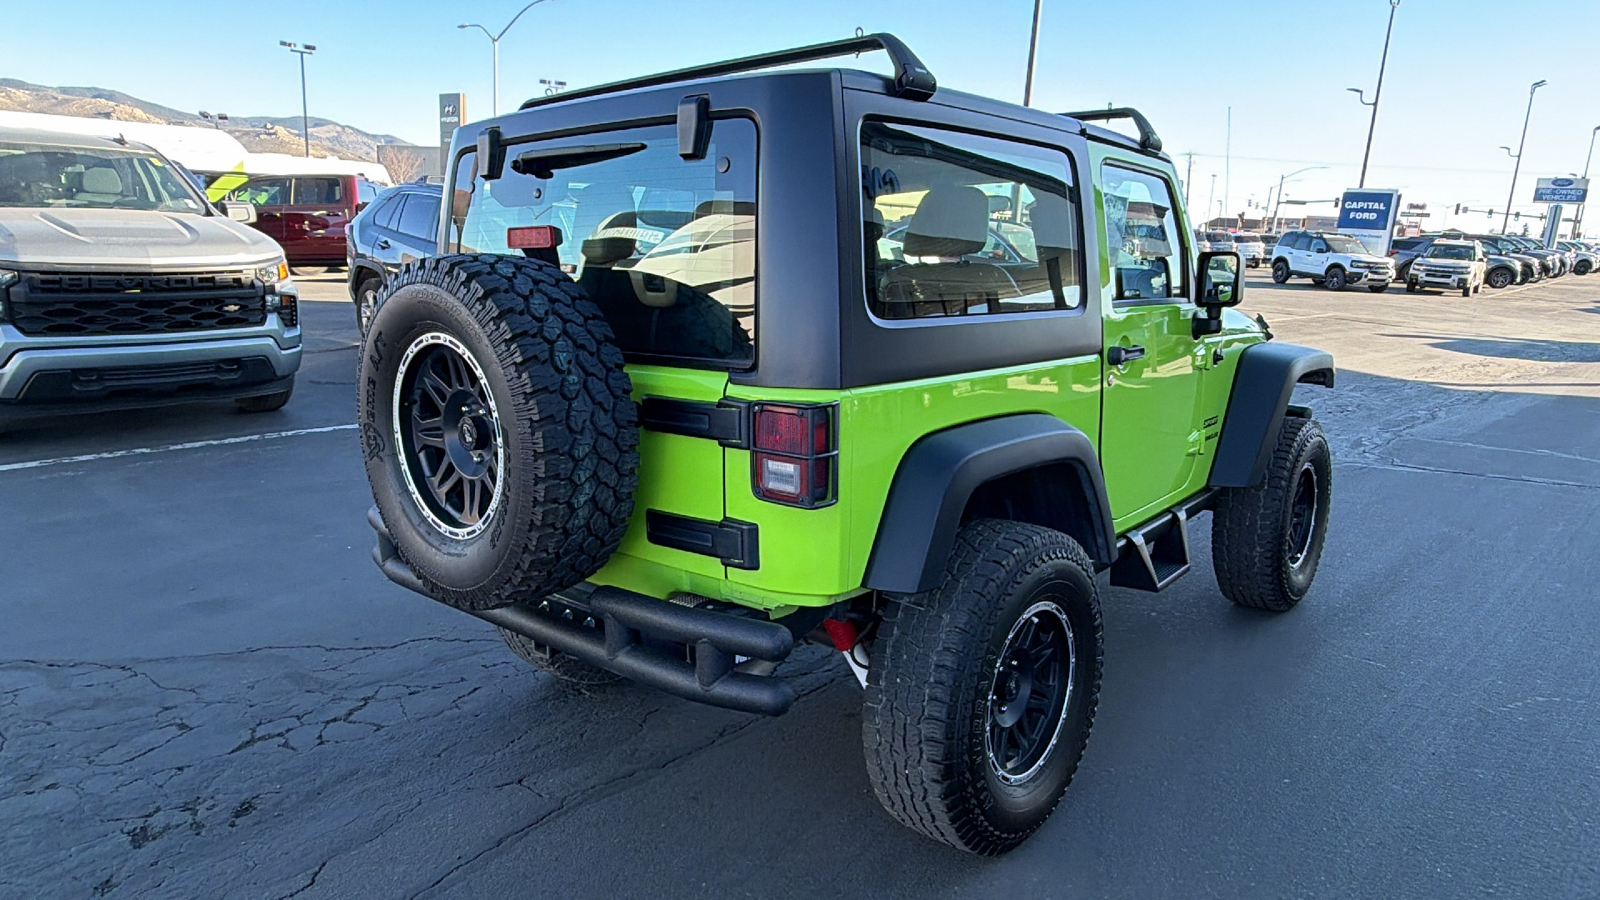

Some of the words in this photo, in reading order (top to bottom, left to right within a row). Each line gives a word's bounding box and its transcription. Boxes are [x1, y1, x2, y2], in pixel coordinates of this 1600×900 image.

[1538, 188, 1583, 196] PRE-OWNED
[1344, 201, 1386, 210] CAPITAL
[1349, 211, 1378, 220] FORD
[37, 274, 254, 289] CHEVROLET
